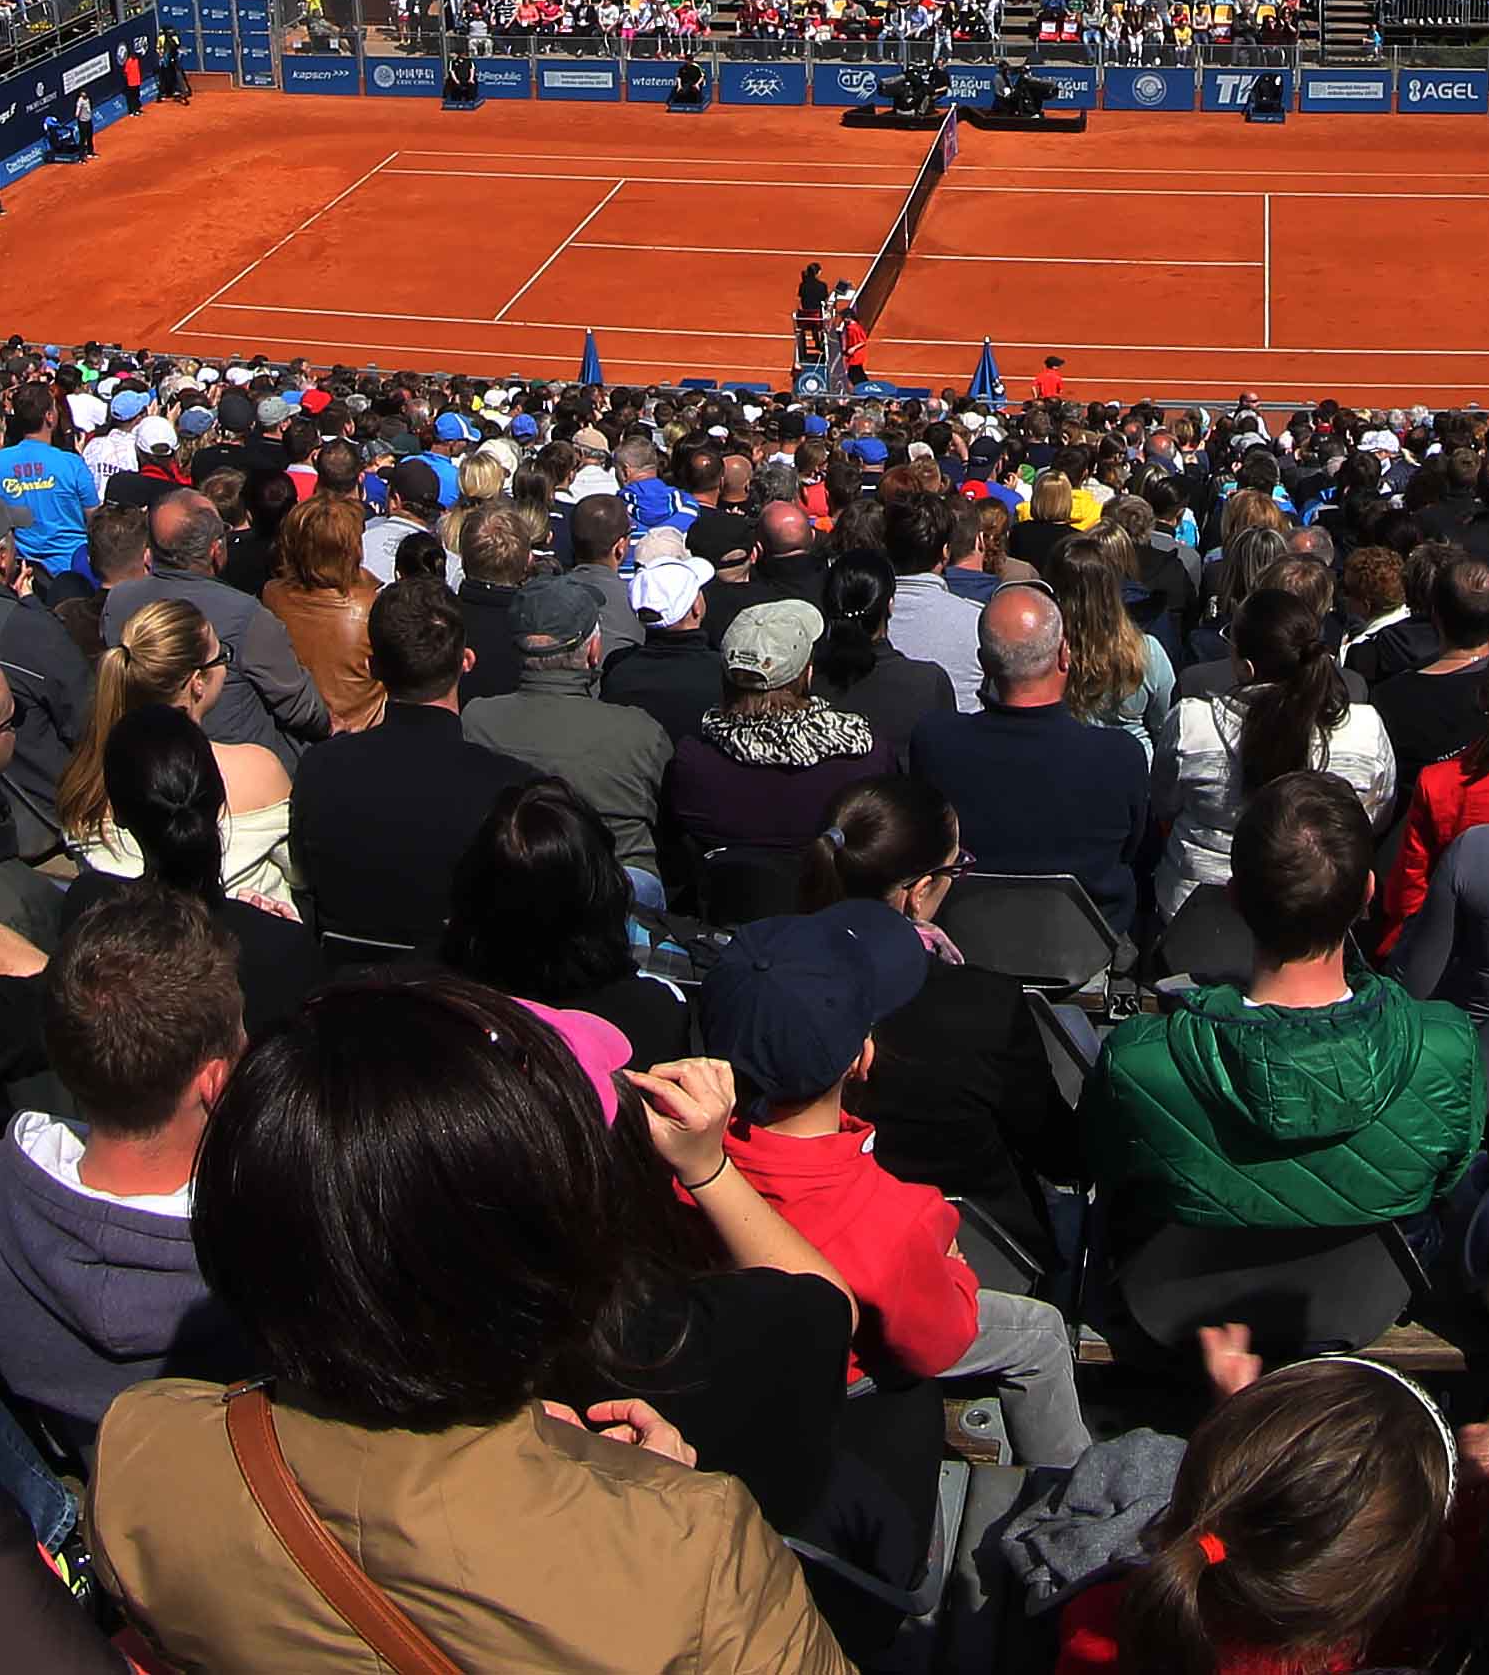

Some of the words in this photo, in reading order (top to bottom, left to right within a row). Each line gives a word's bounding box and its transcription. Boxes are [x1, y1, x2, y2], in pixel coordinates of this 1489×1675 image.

[292, 69, 332, 80] kapsch
[951, 80, 991, 90] RAGUE
[1422, 82, 1479, 100] AGEL
